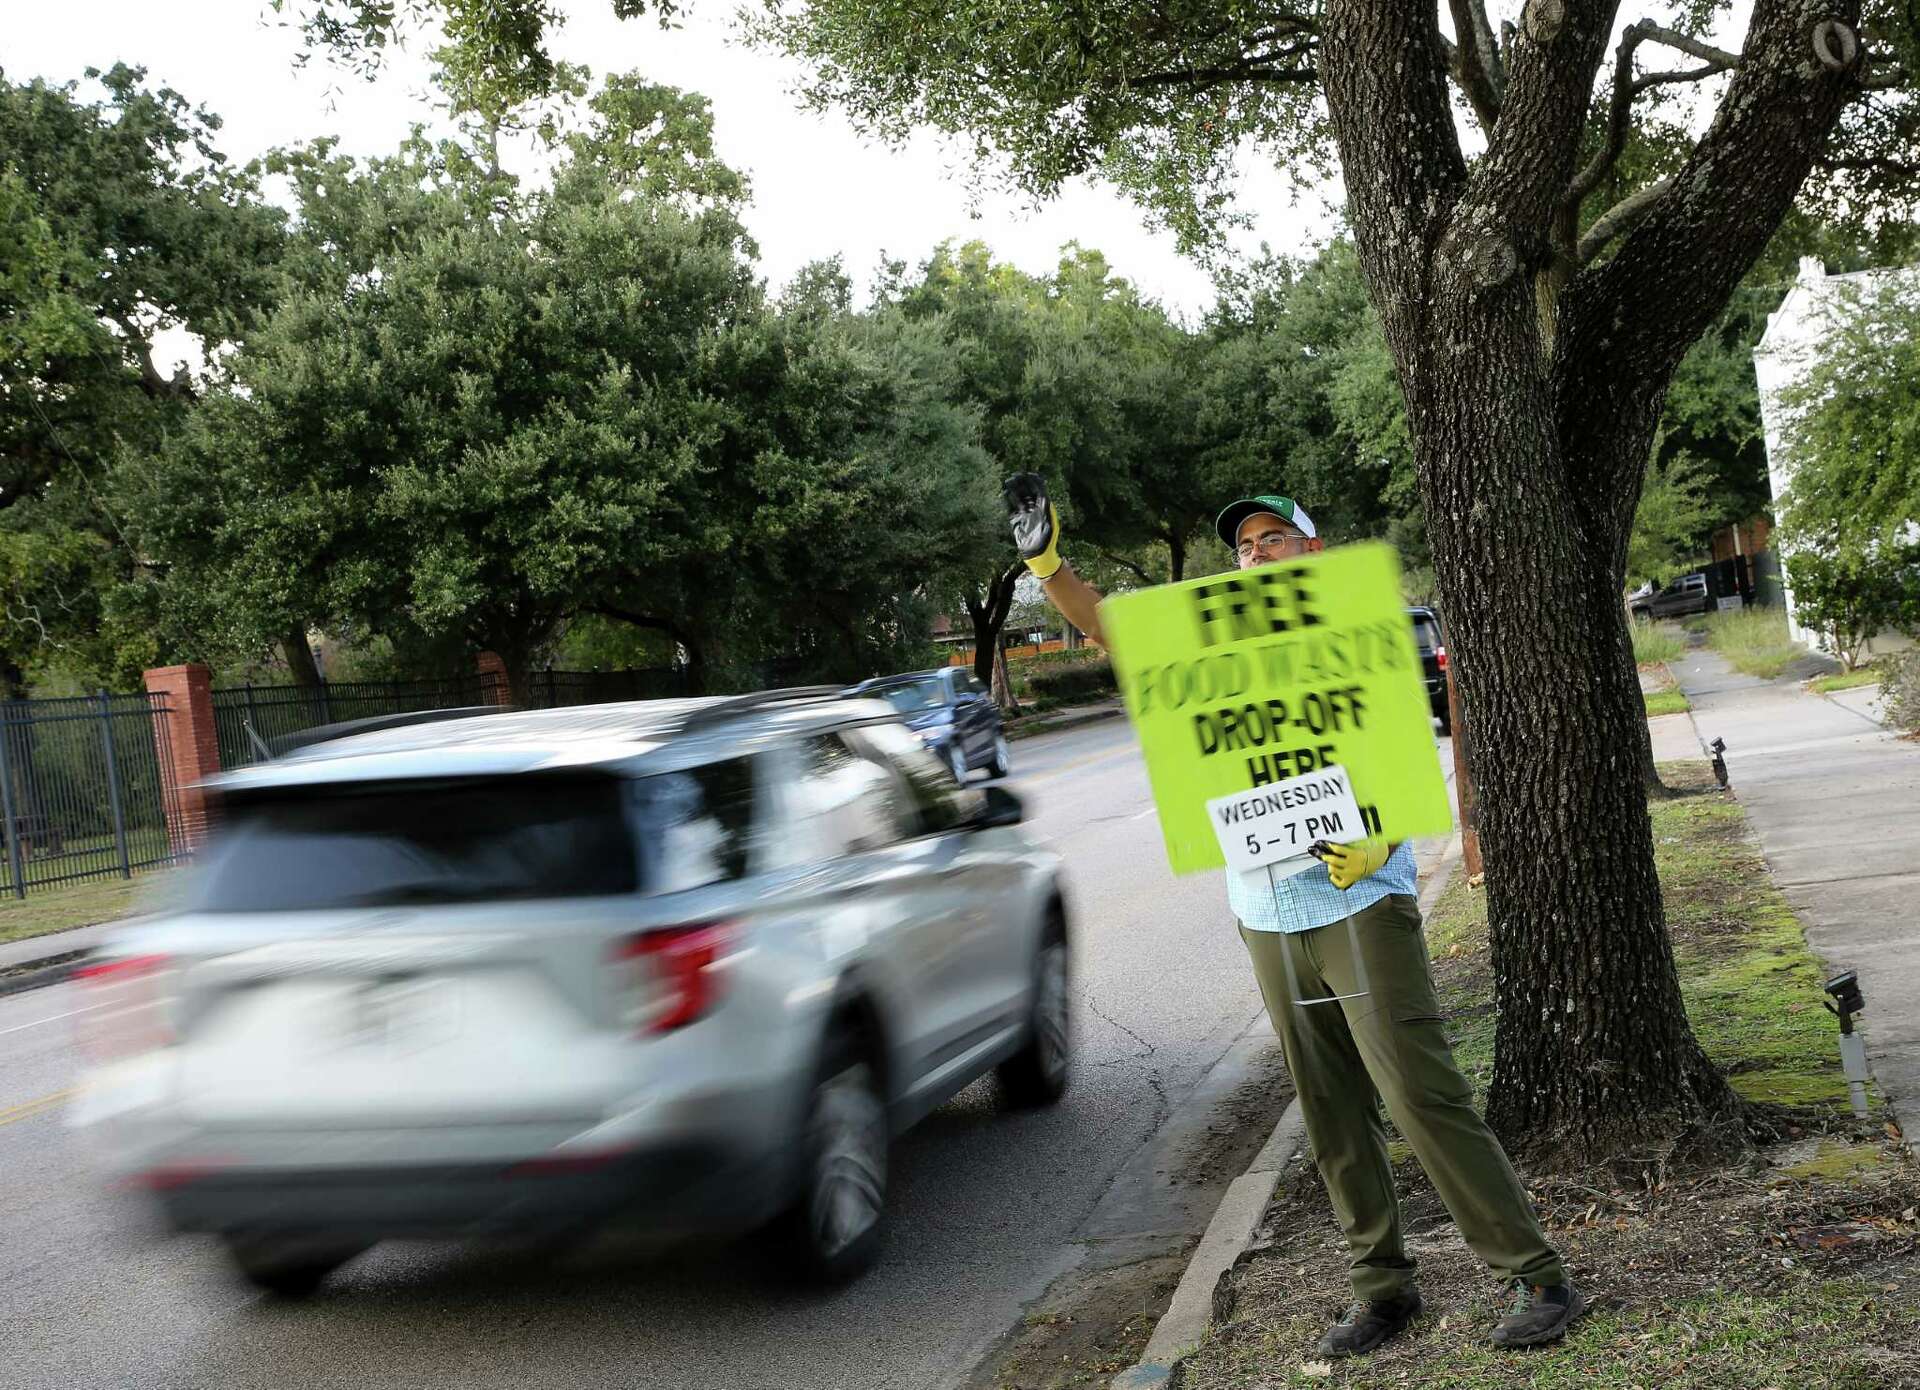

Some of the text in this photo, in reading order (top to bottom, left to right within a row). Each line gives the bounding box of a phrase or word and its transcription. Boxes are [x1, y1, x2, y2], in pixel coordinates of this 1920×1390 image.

[1191, 568, 1321, 647] FREE
[1136, 652, 1250, 716] FOOD
[1195, 686, 1367, 754] DROP-OFF
[1218, 775, 1345, 826] WEDNESDAY
[1305, 811, 1344, 839] PM
